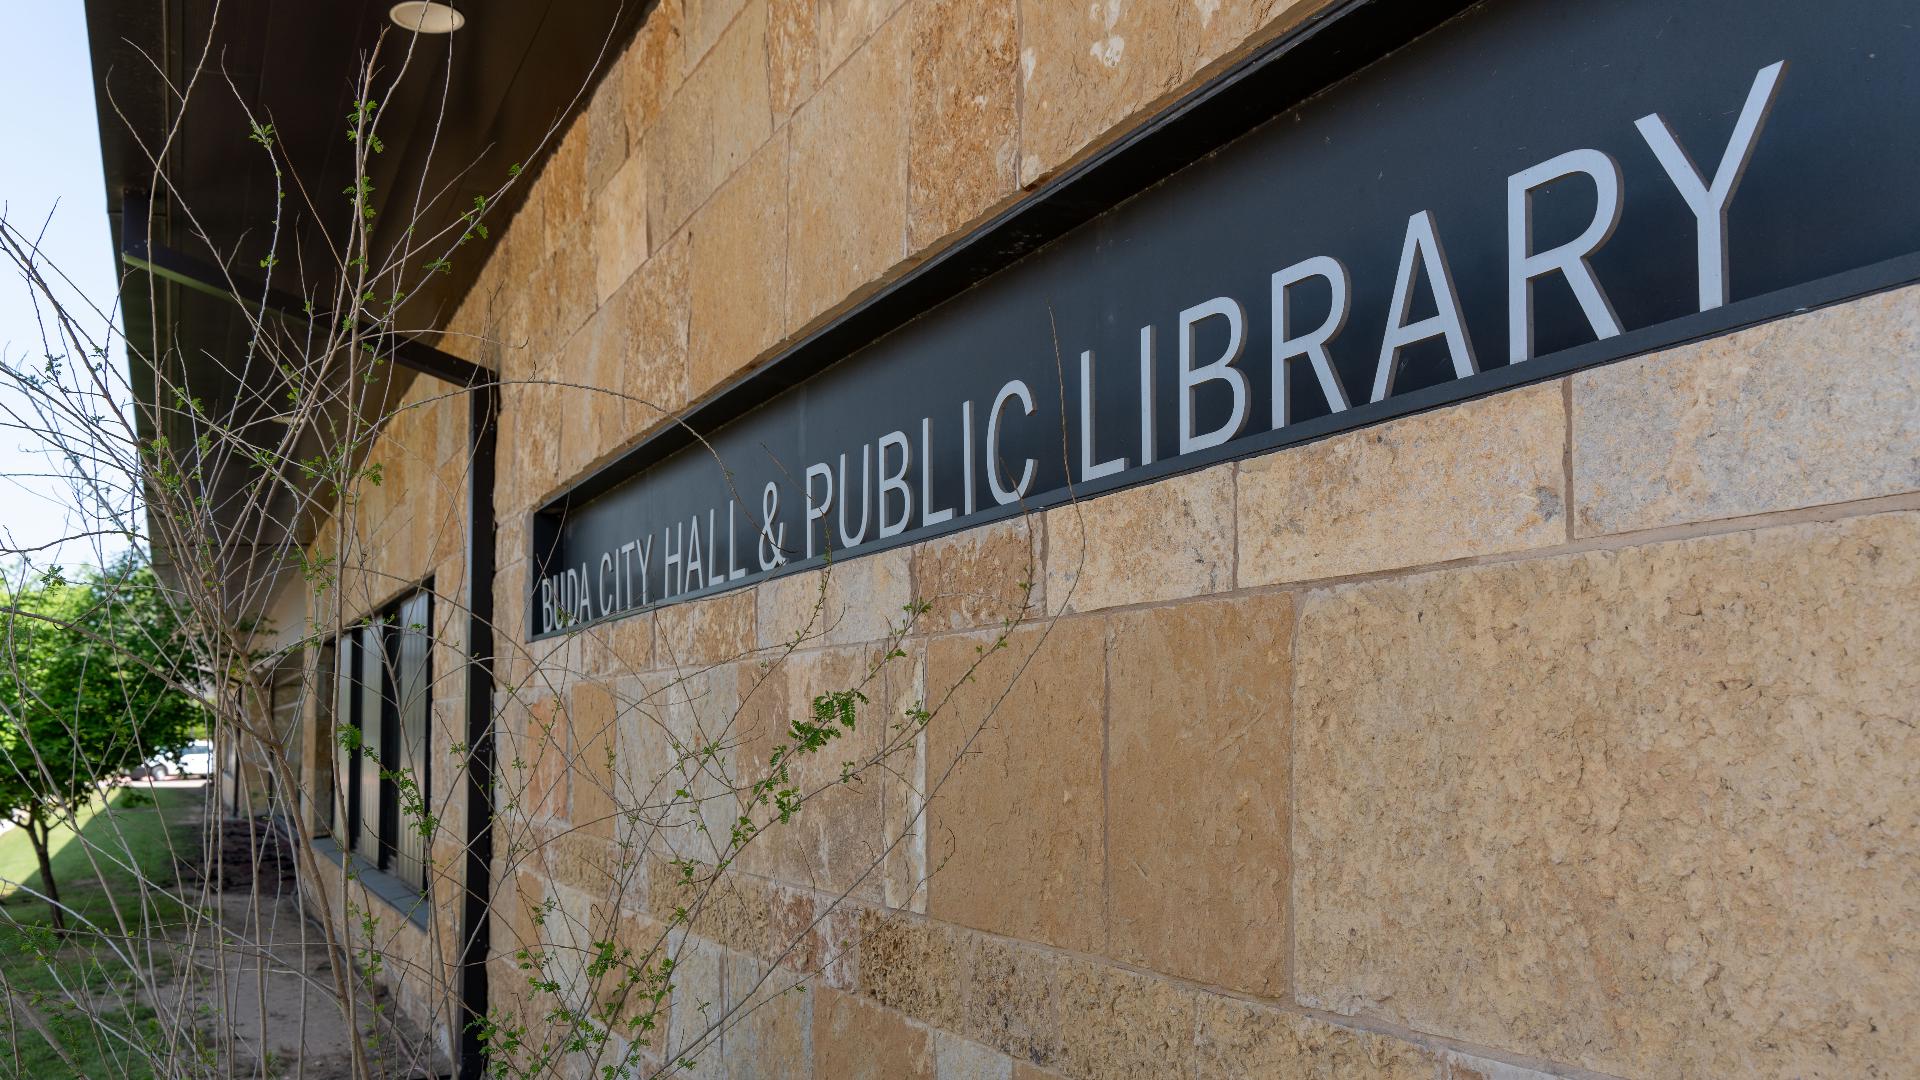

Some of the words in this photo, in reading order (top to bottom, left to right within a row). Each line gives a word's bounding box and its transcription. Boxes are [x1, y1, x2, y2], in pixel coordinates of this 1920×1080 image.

[542, 562, 593, 633] BUDA
[600, 534, 653, 616] CITY
[665, 500, 746, 599] HALL
[758, 481, 787, 571] &
[806, 379, 1038, 559] PUBLIC
[1081, 60, 1788, 482] LIBRARY
